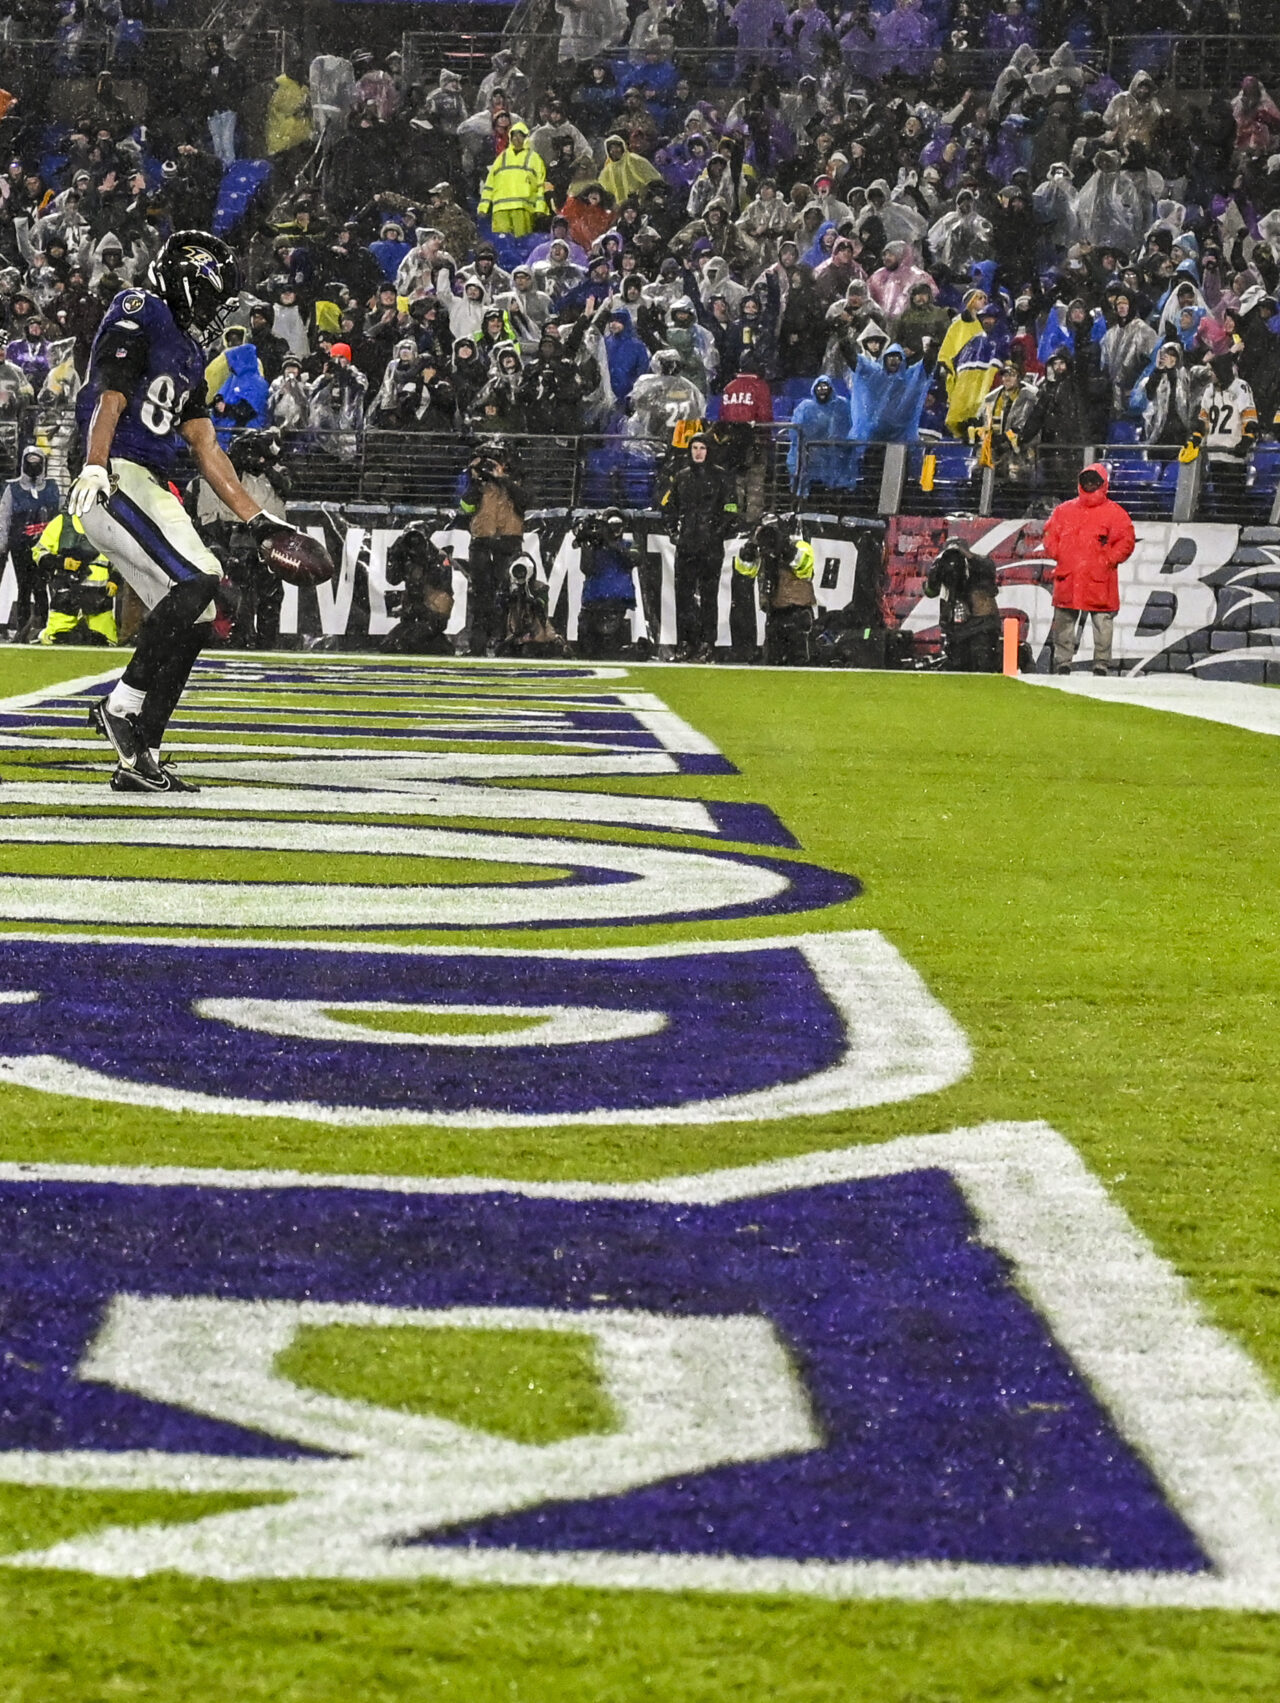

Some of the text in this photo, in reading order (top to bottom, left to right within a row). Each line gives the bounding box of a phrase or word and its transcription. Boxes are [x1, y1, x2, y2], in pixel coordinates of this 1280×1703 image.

[722, 392, 754, 405] S.A.F.E.
[1209, 404, 1234, 435] 92
[250, 525, 472, 637] IVES
